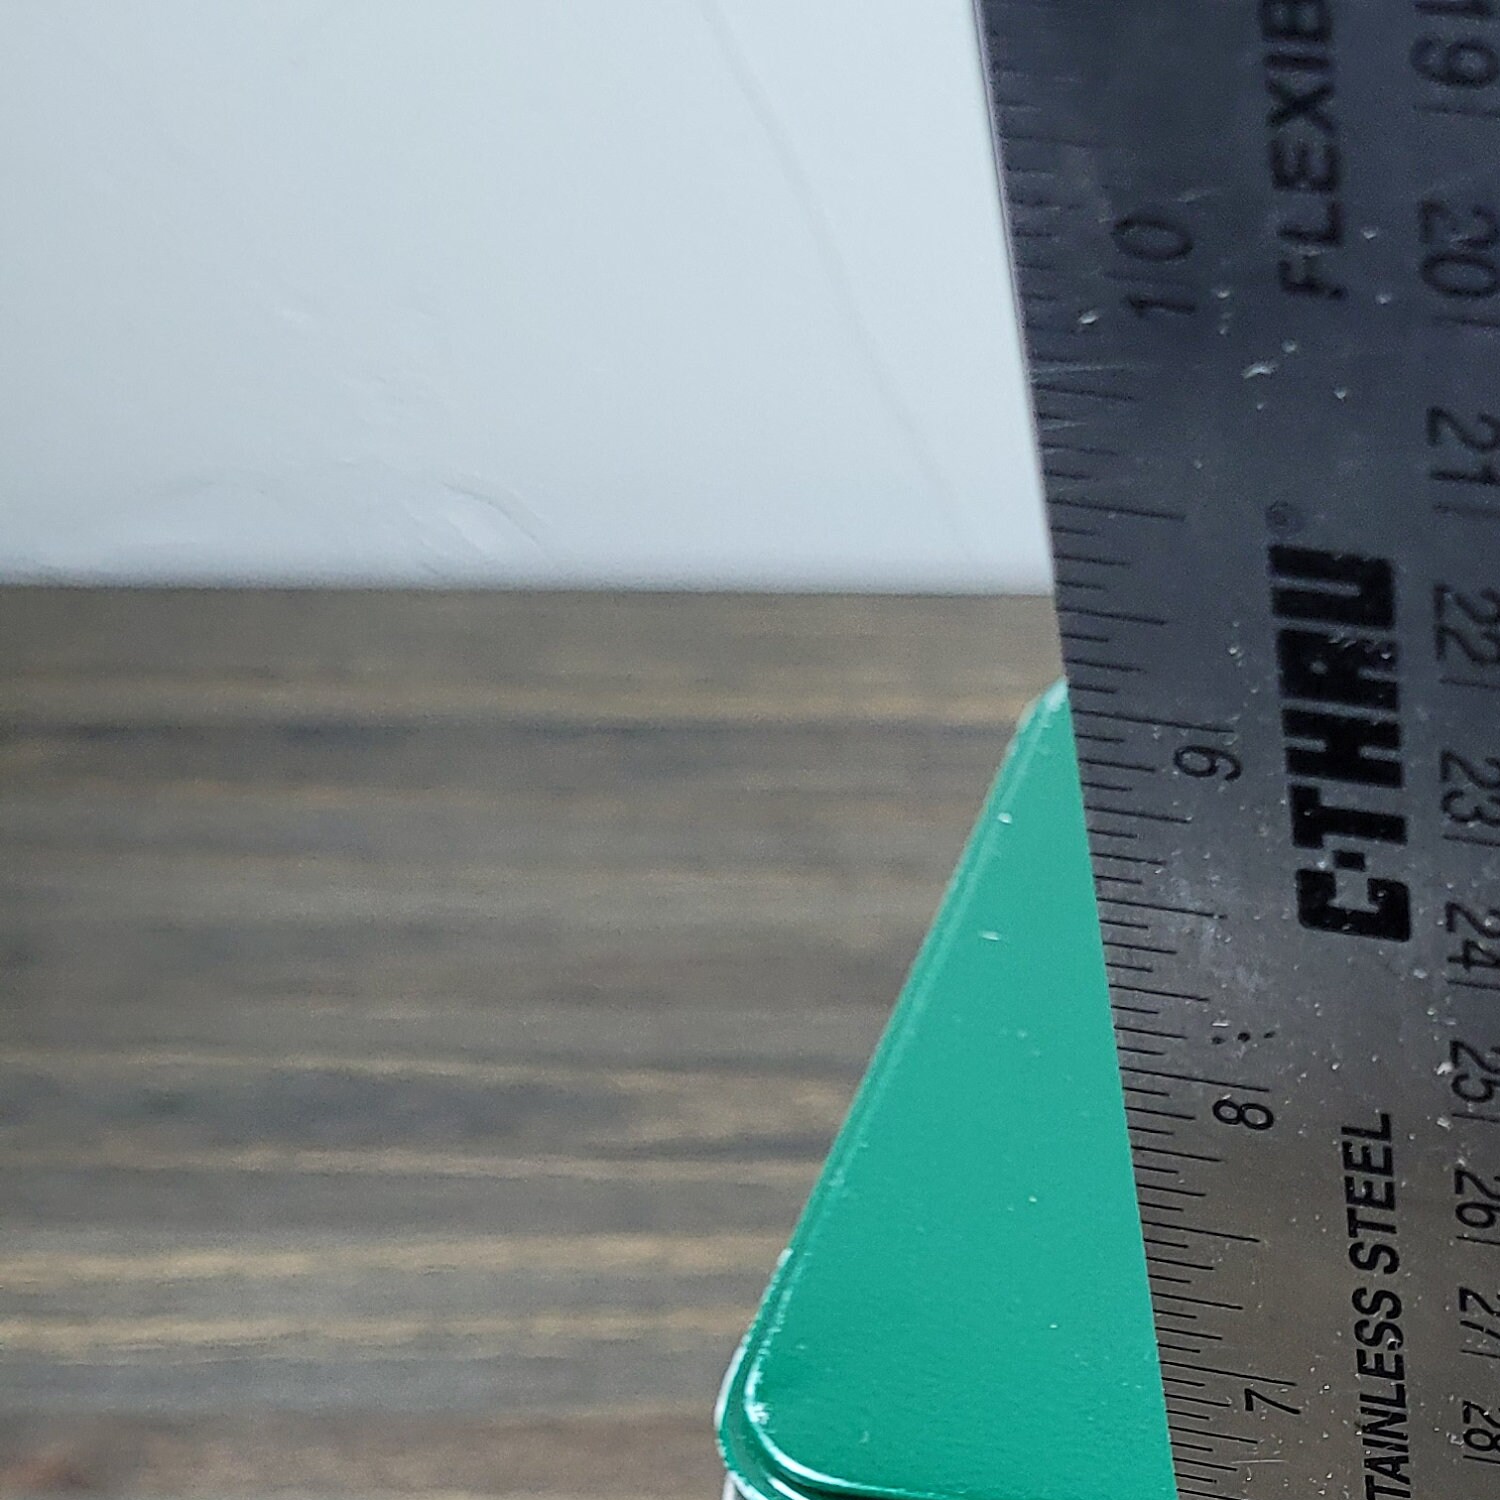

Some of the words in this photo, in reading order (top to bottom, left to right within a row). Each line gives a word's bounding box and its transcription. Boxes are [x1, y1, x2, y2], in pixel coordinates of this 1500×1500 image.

[1109, 212, 1195, 316] 10
[1212, 1100, 1274, 1131] 8
[1341, 1114, 1399, 1275] STEEL
[1244, 1388, 1300, 1414] 7
